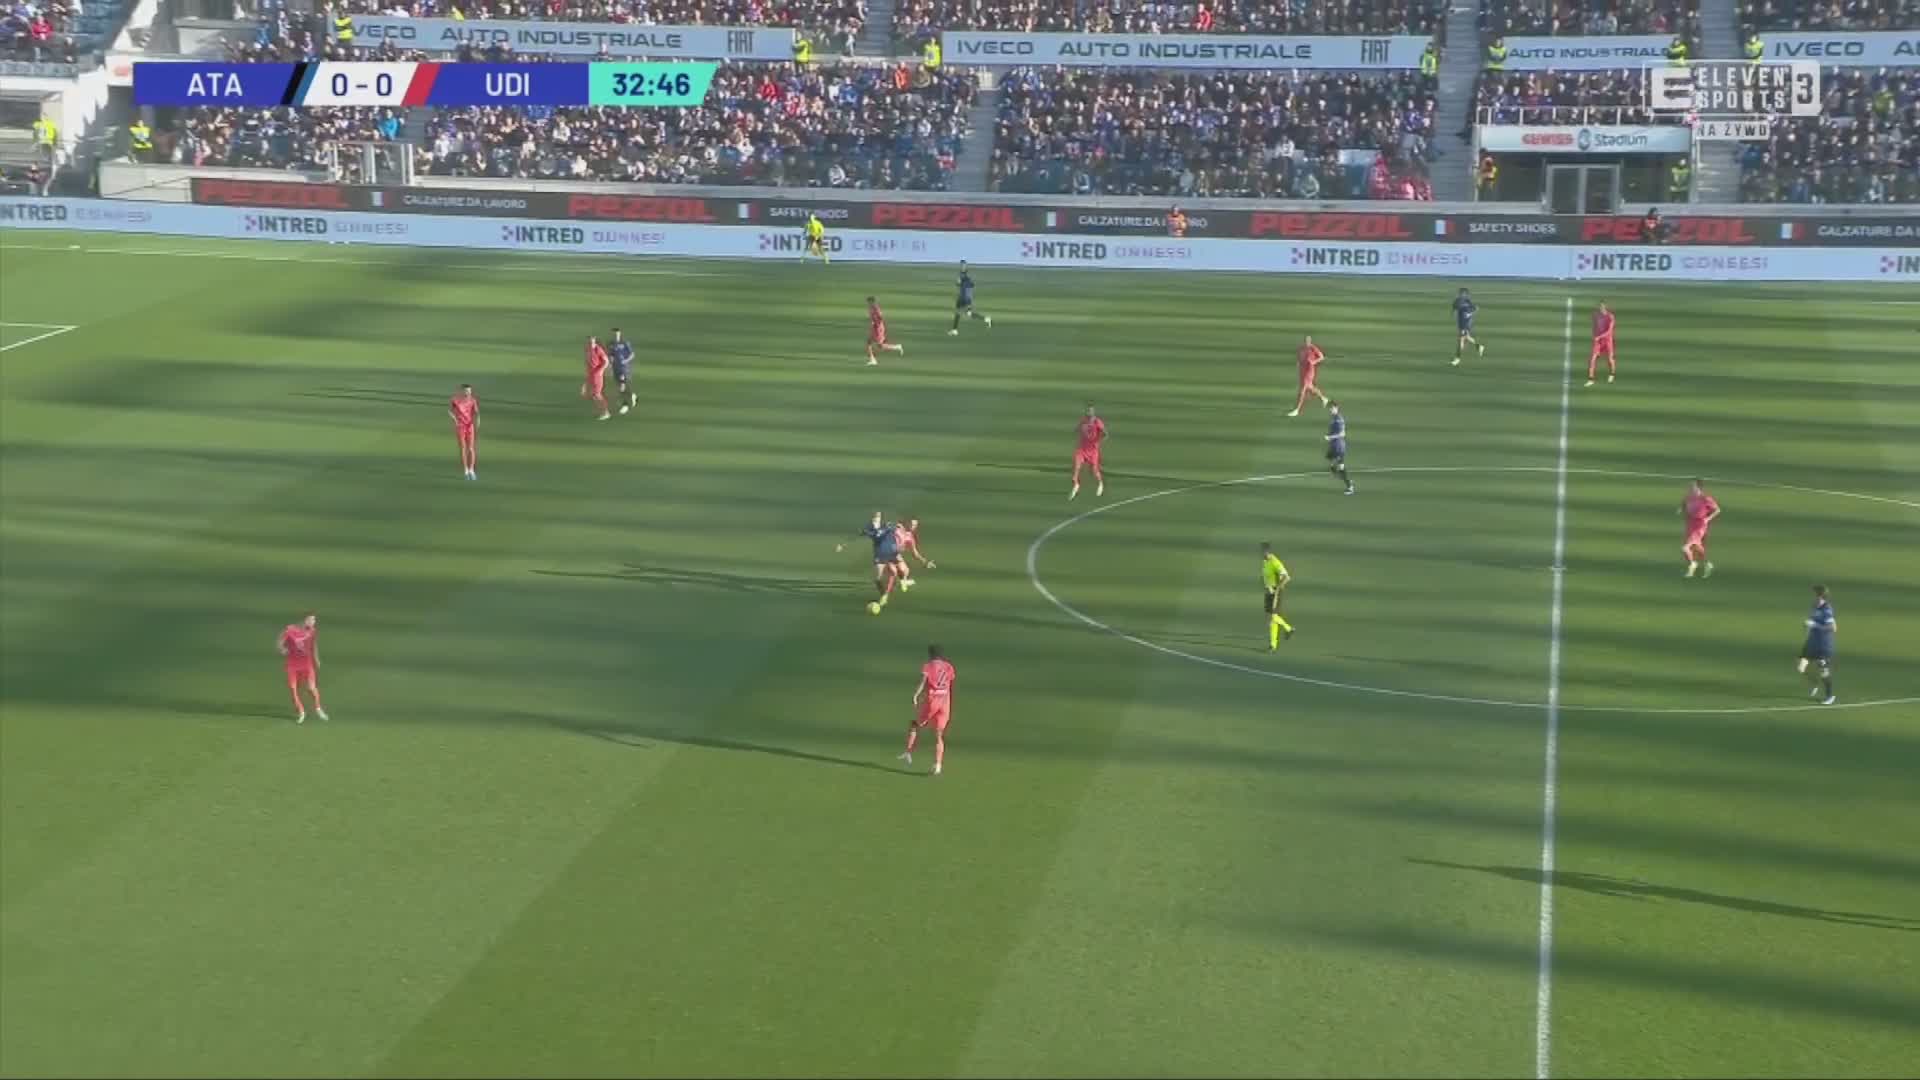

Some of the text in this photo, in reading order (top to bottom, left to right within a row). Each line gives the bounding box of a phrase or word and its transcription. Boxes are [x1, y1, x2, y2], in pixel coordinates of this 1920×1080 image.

[345, 25, 682, 48] VECO AUTO INDUSTRIALE
[727, 30, 755, 53] FIAT
[957, 40, 1312, 58] IVECO AUTO INDUSTRIALE
[1361, 39, 1391, 63] FIAT
[1509, 48, 1556, 58] AUTO
[1775, 41, 1865, 56] IVECO
[1594, 133, 1648, 146] Stadium
[485, 199, 527, 209] LAVORO
[258, 215, 328, 234] INTRED
[1078, 215, 1143, 226] CALZATURE
[1145, 218, 1160, 228] DA
[1469, 223, 1557, 234] SAFETY SHOES
[515, 226, 584, 244] INTRED
[1817, 225, 1892, 237] CALZATURE
[1035, 241, 1107, 260] INTRED
[1305, 247, 1380, 266] INTRED
[1592, 253, 1673, 271] INTRED
